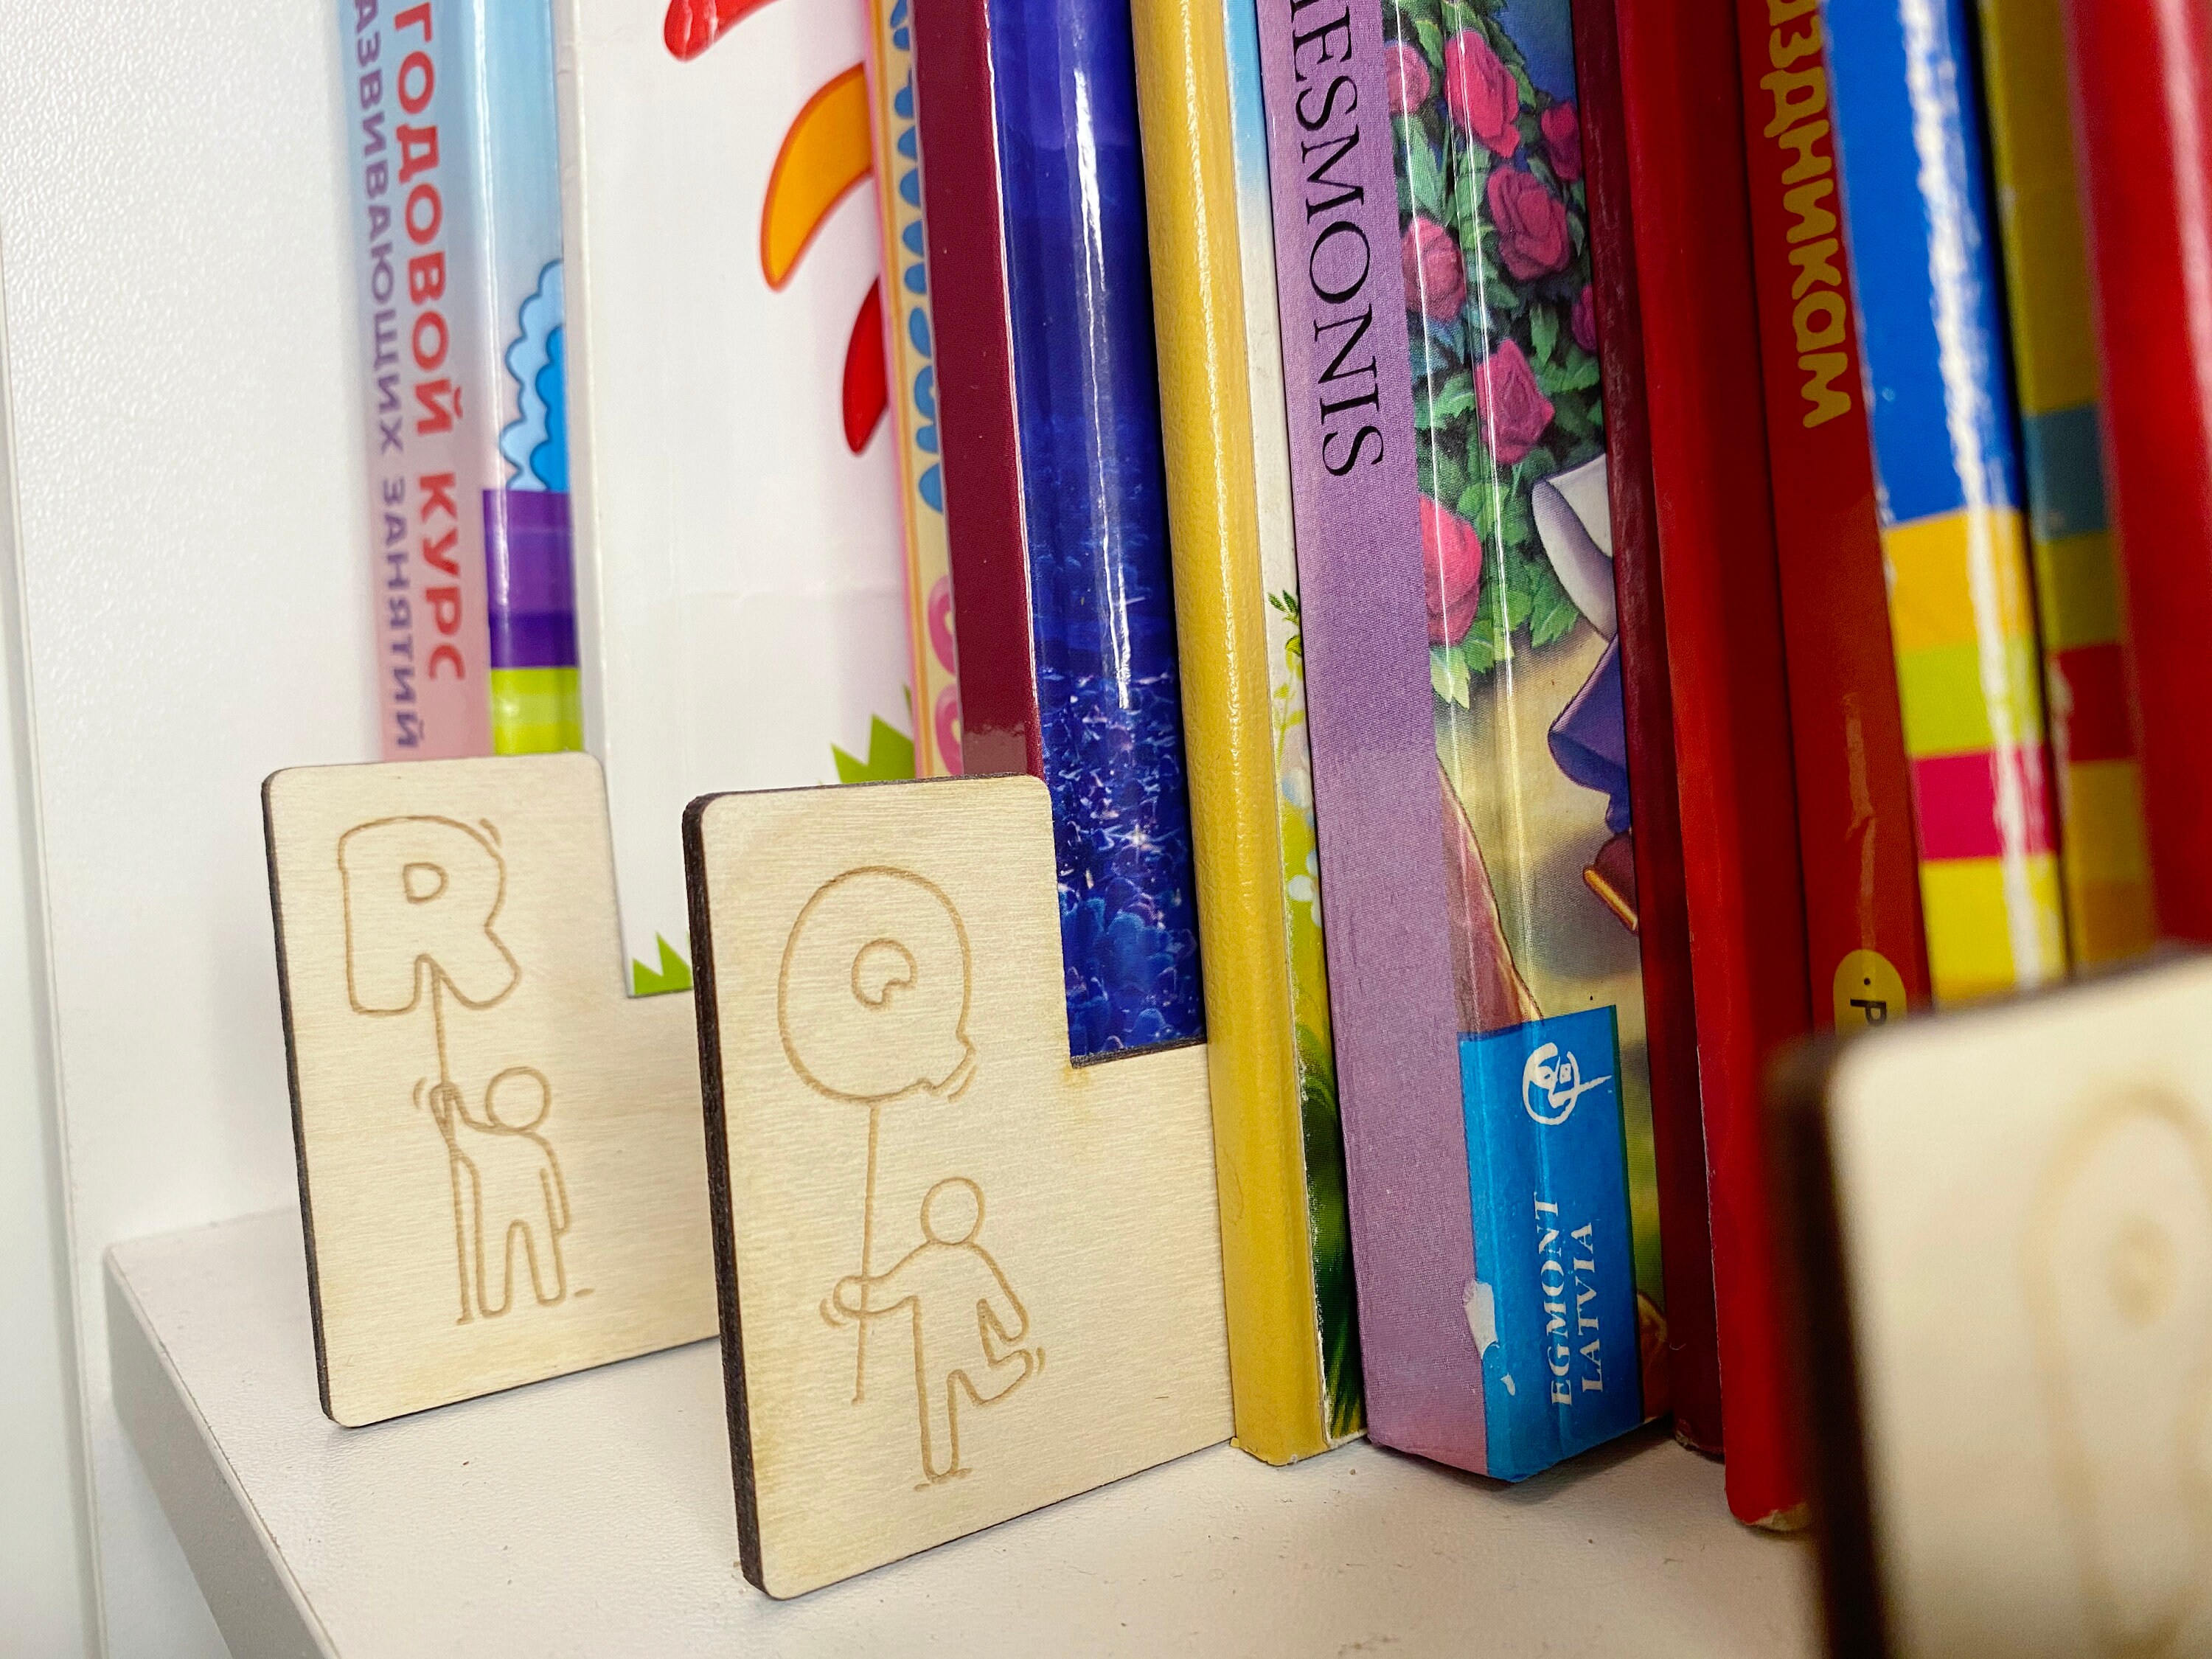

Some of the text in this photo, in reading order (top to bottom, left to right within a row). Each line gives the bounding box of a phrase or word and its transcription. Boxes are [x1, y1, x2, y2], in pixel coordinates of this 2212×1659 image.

[394, 1, 466, 681] ГОДОВОЙ КУРС
[381, 476, 425, 748] ЗАНЯТИЙ
[337, 814, 523, 1018] R
[777, 864, 977, 1104] Q
[1534, 1192, 1572, 1405] EGMONT
[1571, 1222, 1603, 1392] LATVIA
